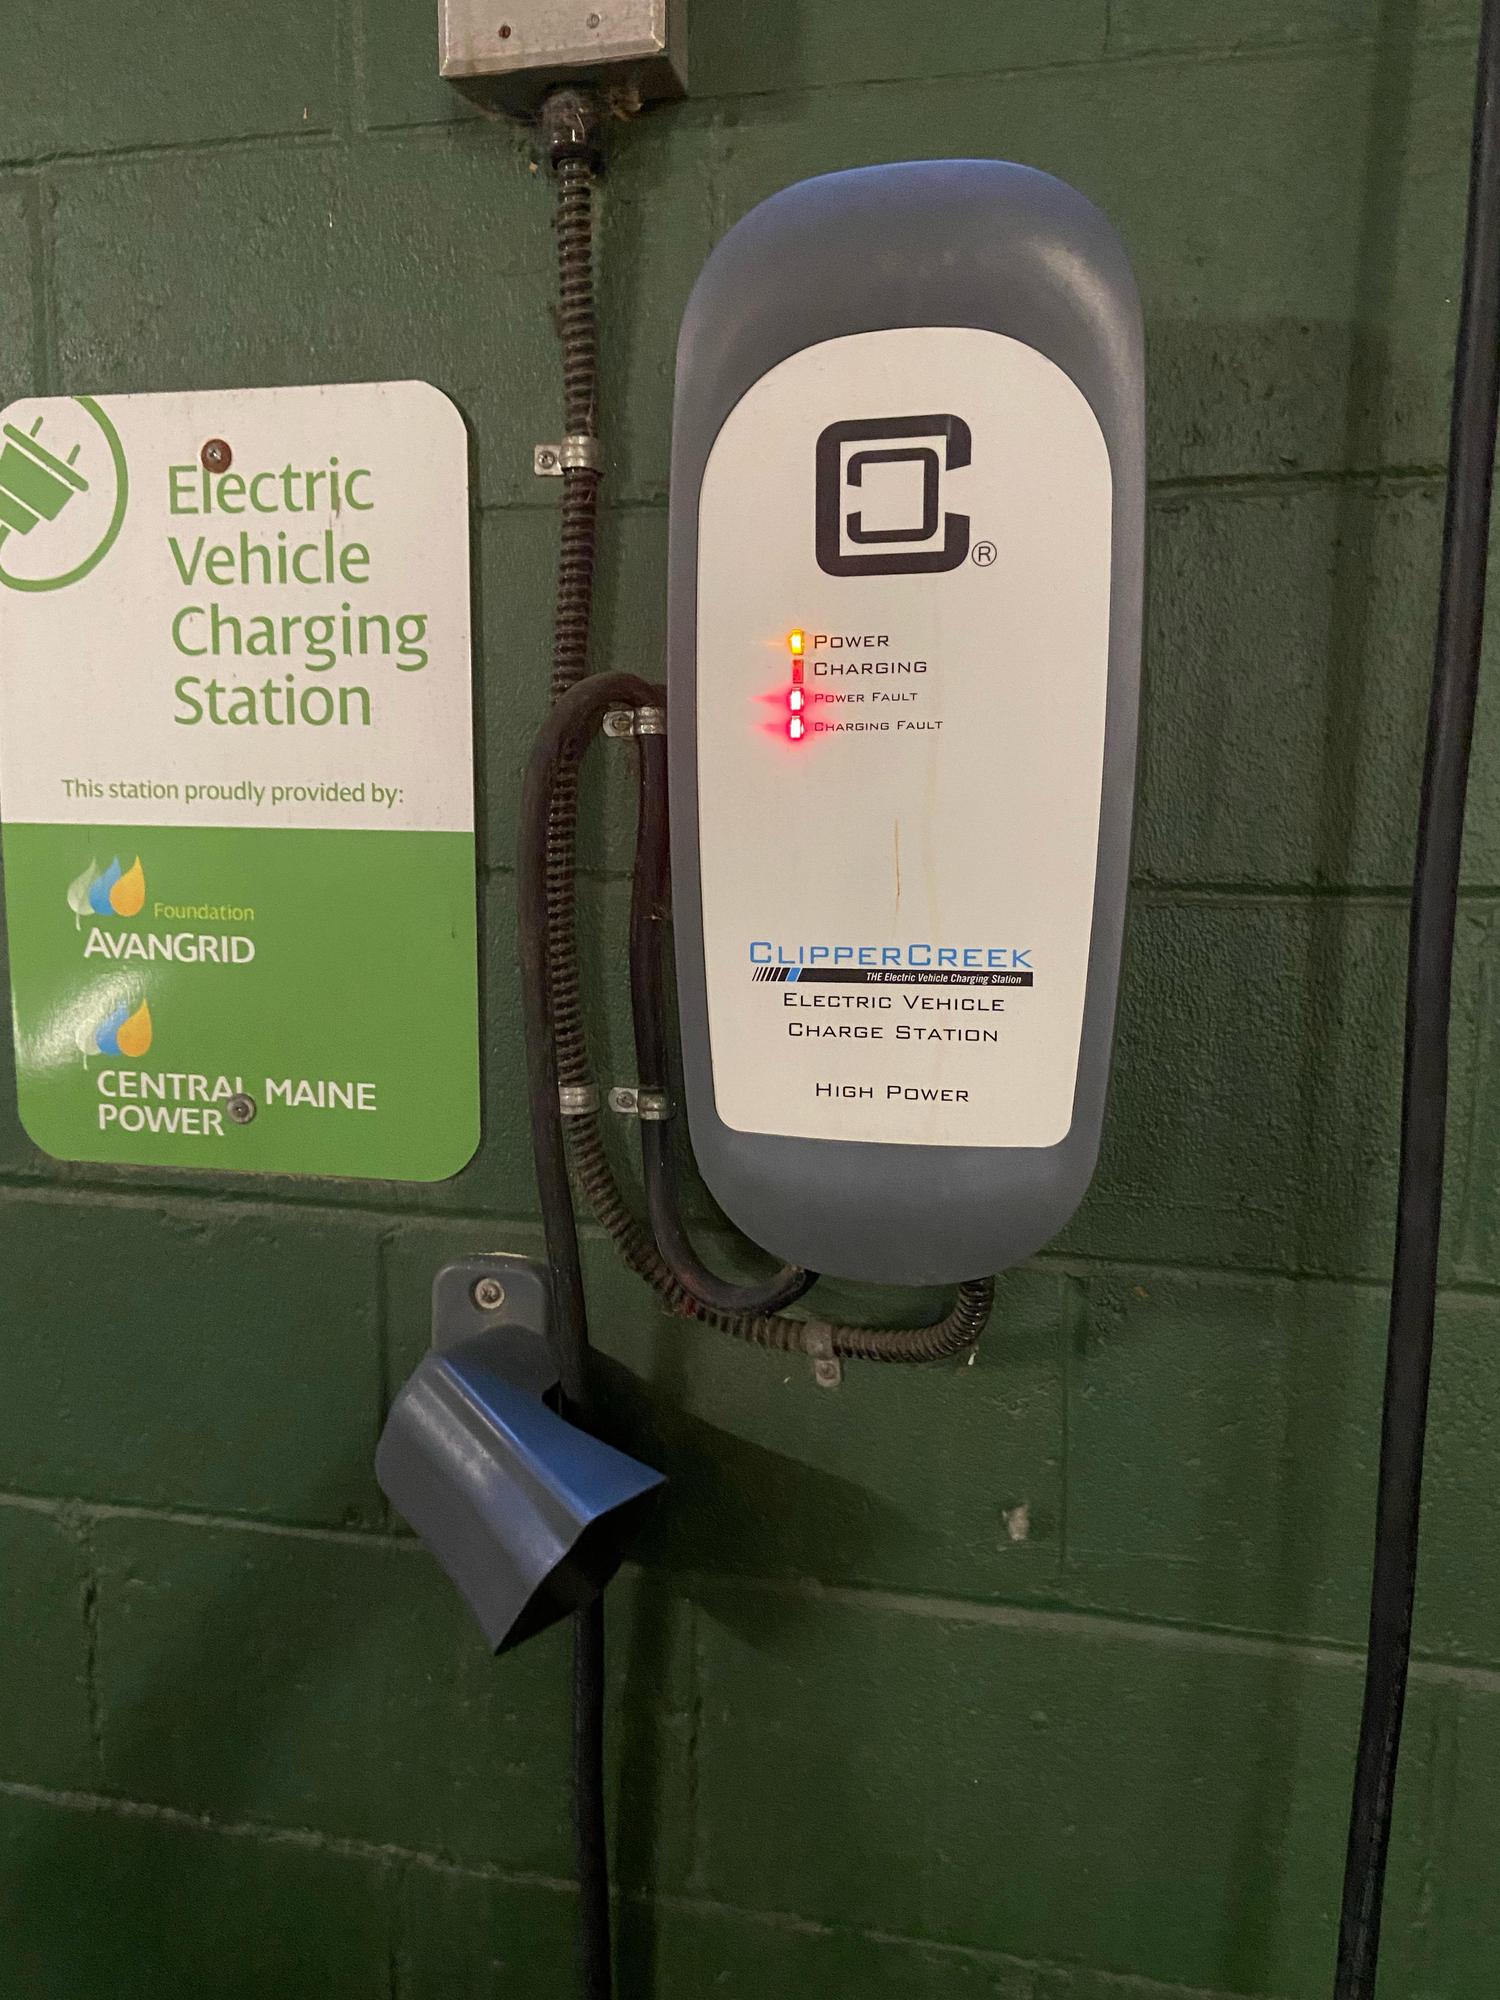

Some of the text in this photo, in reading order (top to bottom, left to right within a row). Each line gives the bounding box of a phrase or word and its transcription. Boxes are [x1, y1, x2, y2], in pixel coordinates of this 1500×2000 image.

[168, 456, 375, 514] Electric
[168, 529, 370, 585] Vehicle
[172, 602, 429, 671] Charging
[814, 635, 889, 649] POWER
[814, 661, 928, 676] CHARGING
[173, 674, 371, 726] Station
[872, 692, 918, 702] FAULT
[814, 720, 944, 732] CHARGING FAULT
[62, 779, 404, 808] This station proudly provided by:
[154, 902, 255, 921] Foundation
[84, 927, 256, 963] AVANGRID
[866, 972, 1022, 986] THE Electric Vehicle Charging Station
[783, 992, 1005, 1012] ELECTRIC VEHICLE
[788, 1022, 998, 1042] CHARGE STATION
[265, 1078, 377, 1110] MAINE
[815, 1083, 969, 1102] HIGH POWER
[98, 1103, 226, 1136] POWER
